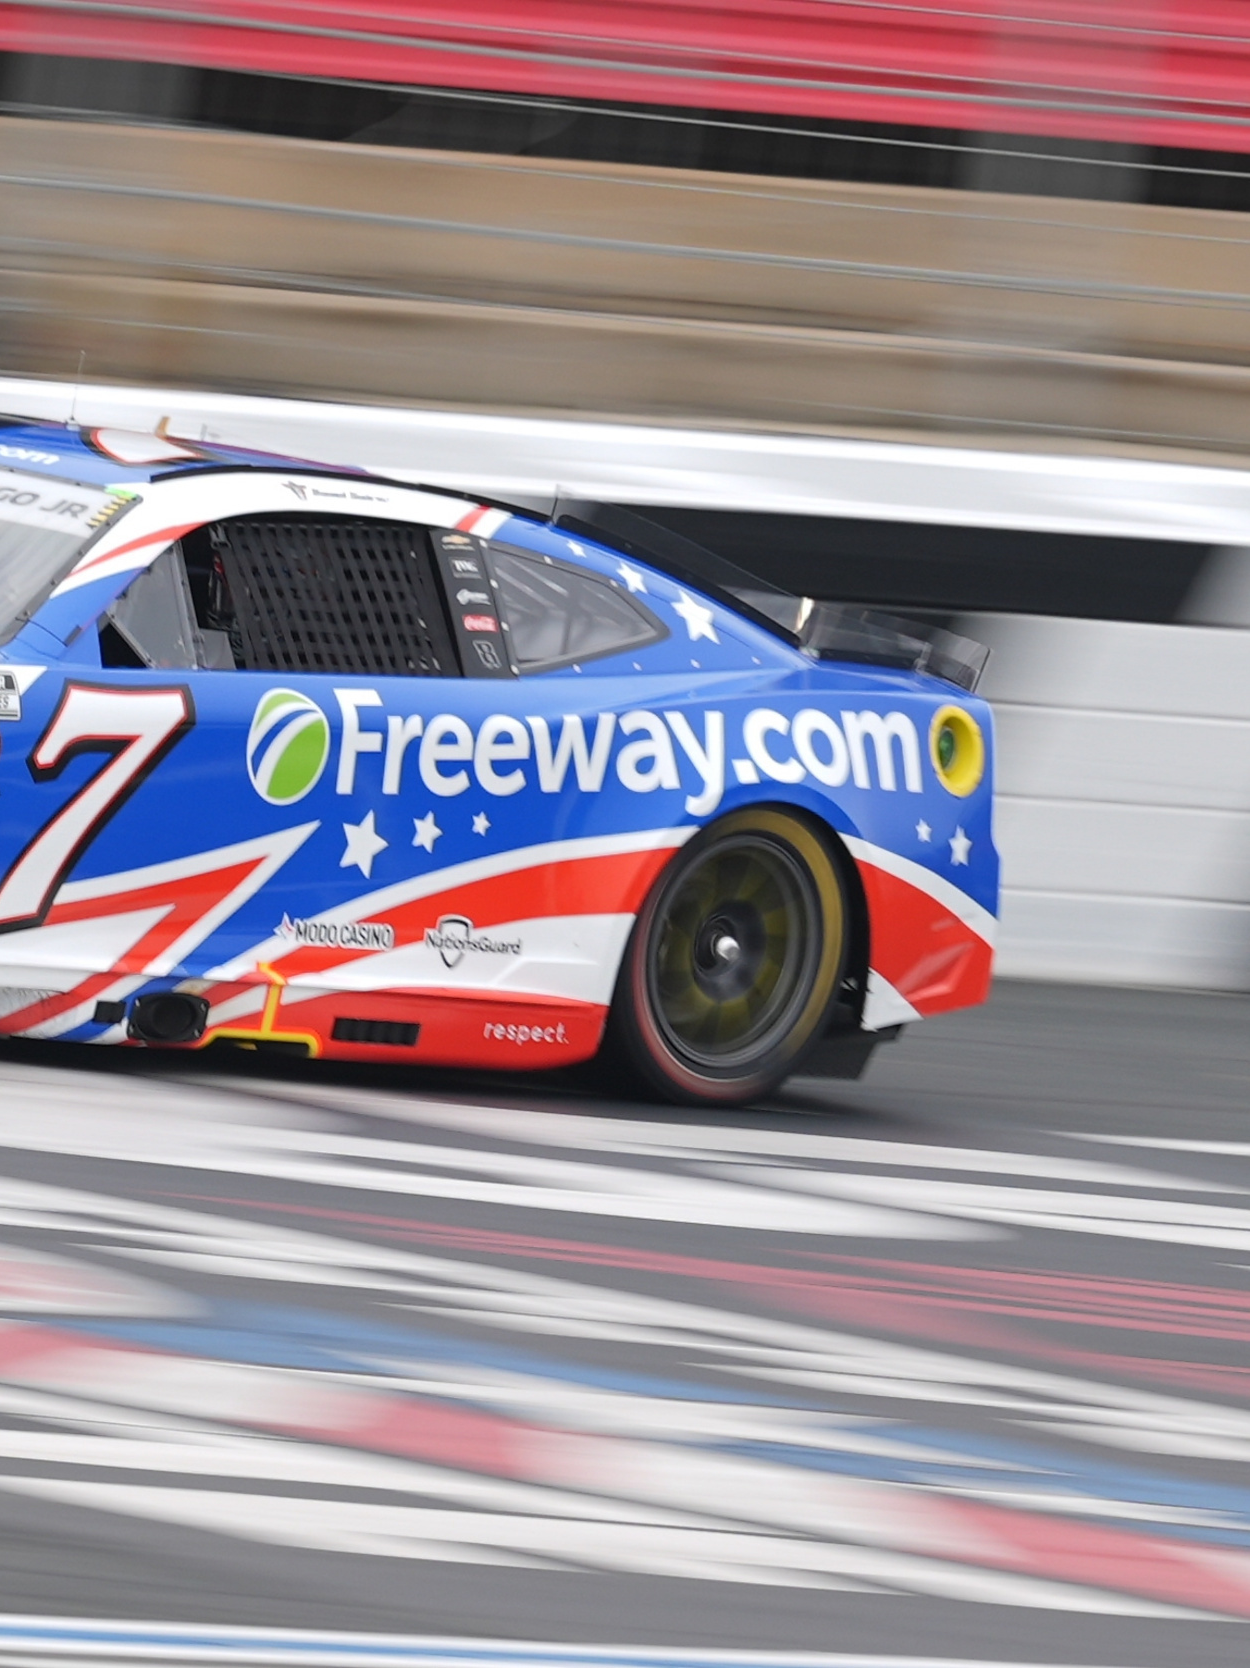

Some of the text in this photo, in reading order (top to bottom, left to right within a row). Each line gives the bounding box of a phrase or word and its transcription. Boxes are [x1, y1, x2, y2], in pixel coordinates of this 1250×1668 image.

[40, 499, 89, 519] JR
[333, 688, 923, 817] Freeway.com
[295, 921, 392, 949] MODO CASINO
